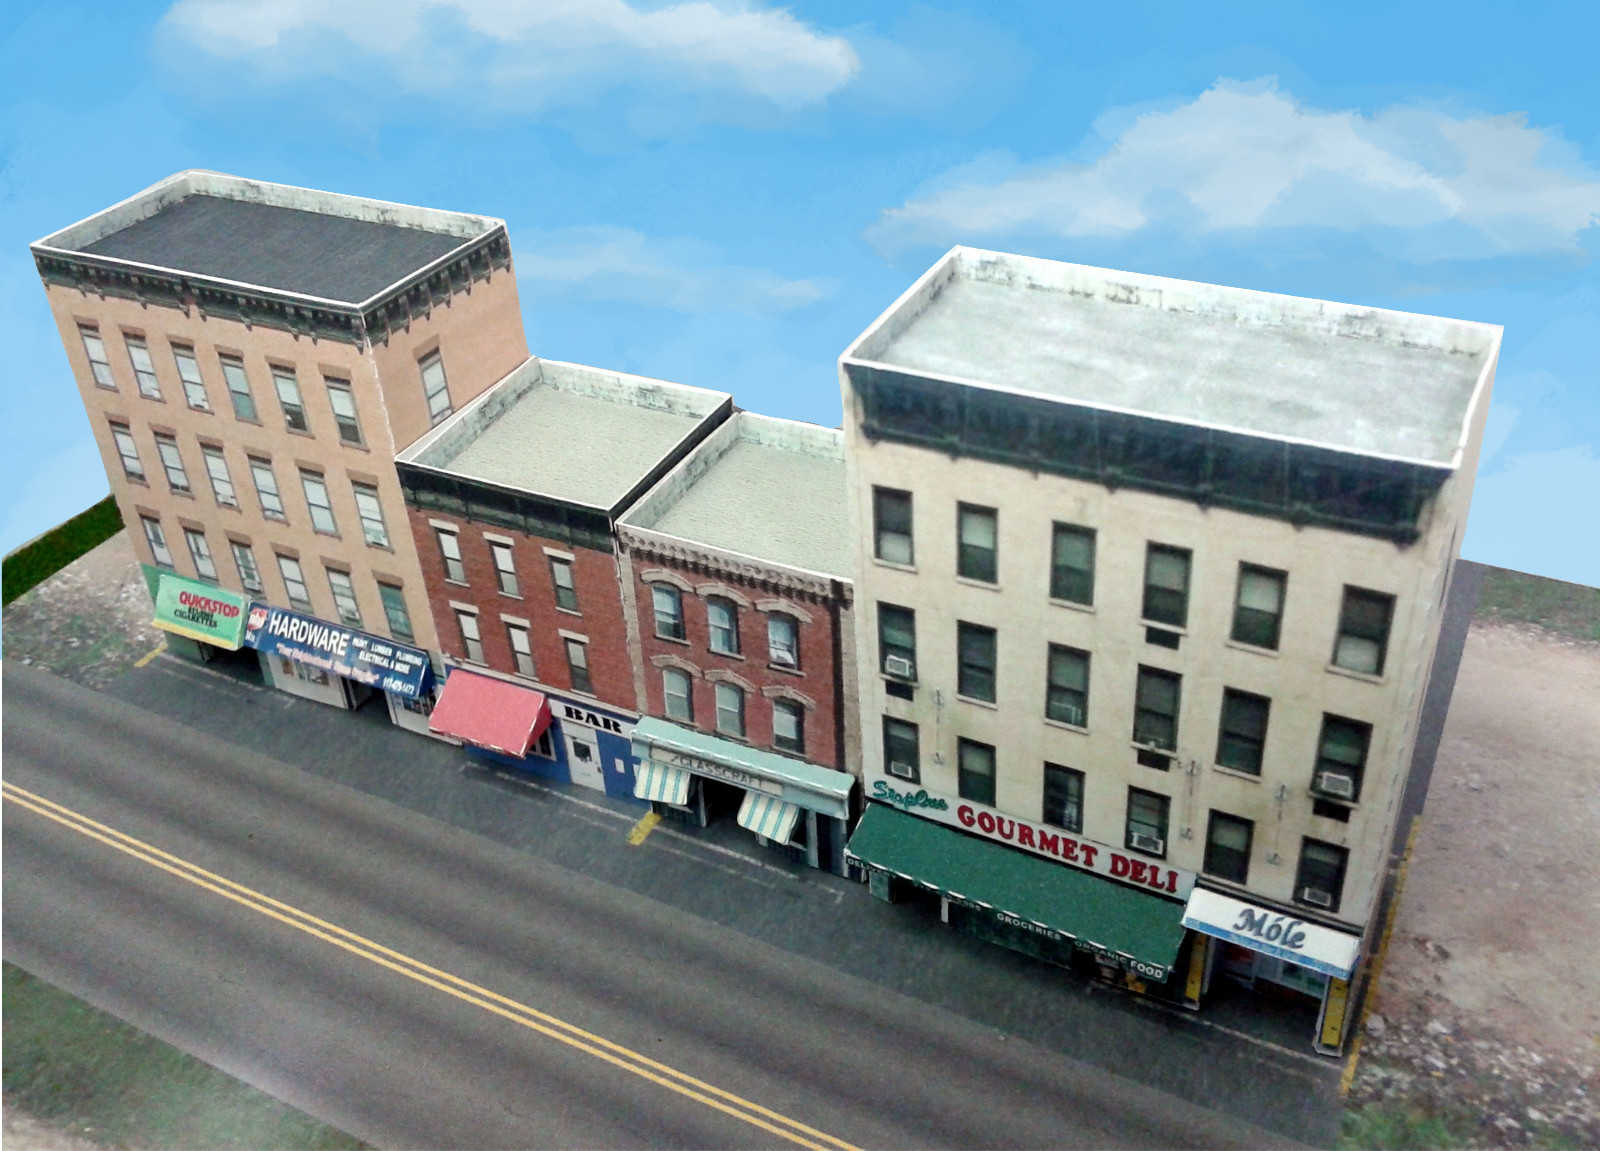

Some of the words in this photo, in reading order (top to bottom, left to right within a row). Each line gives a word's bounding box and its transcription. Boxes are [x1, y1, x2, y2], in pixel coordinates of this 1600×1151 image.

[174, 608, 218, 628] CIGARETTES
[179, 591, 240, 618] QUICKSTOP
[268, 611, 350, 657] HARDWARE
[359, 650, 389, 668] ELECTRICAL
[564, 705, 622, 734] BAR
[957, 804, 1098, 867] GOURMET
[1109, 853, 1179, 893] DELI
[997, 913, 1062, 941] GROCERIES
[1130, 960, 1163, 979] FOOD
